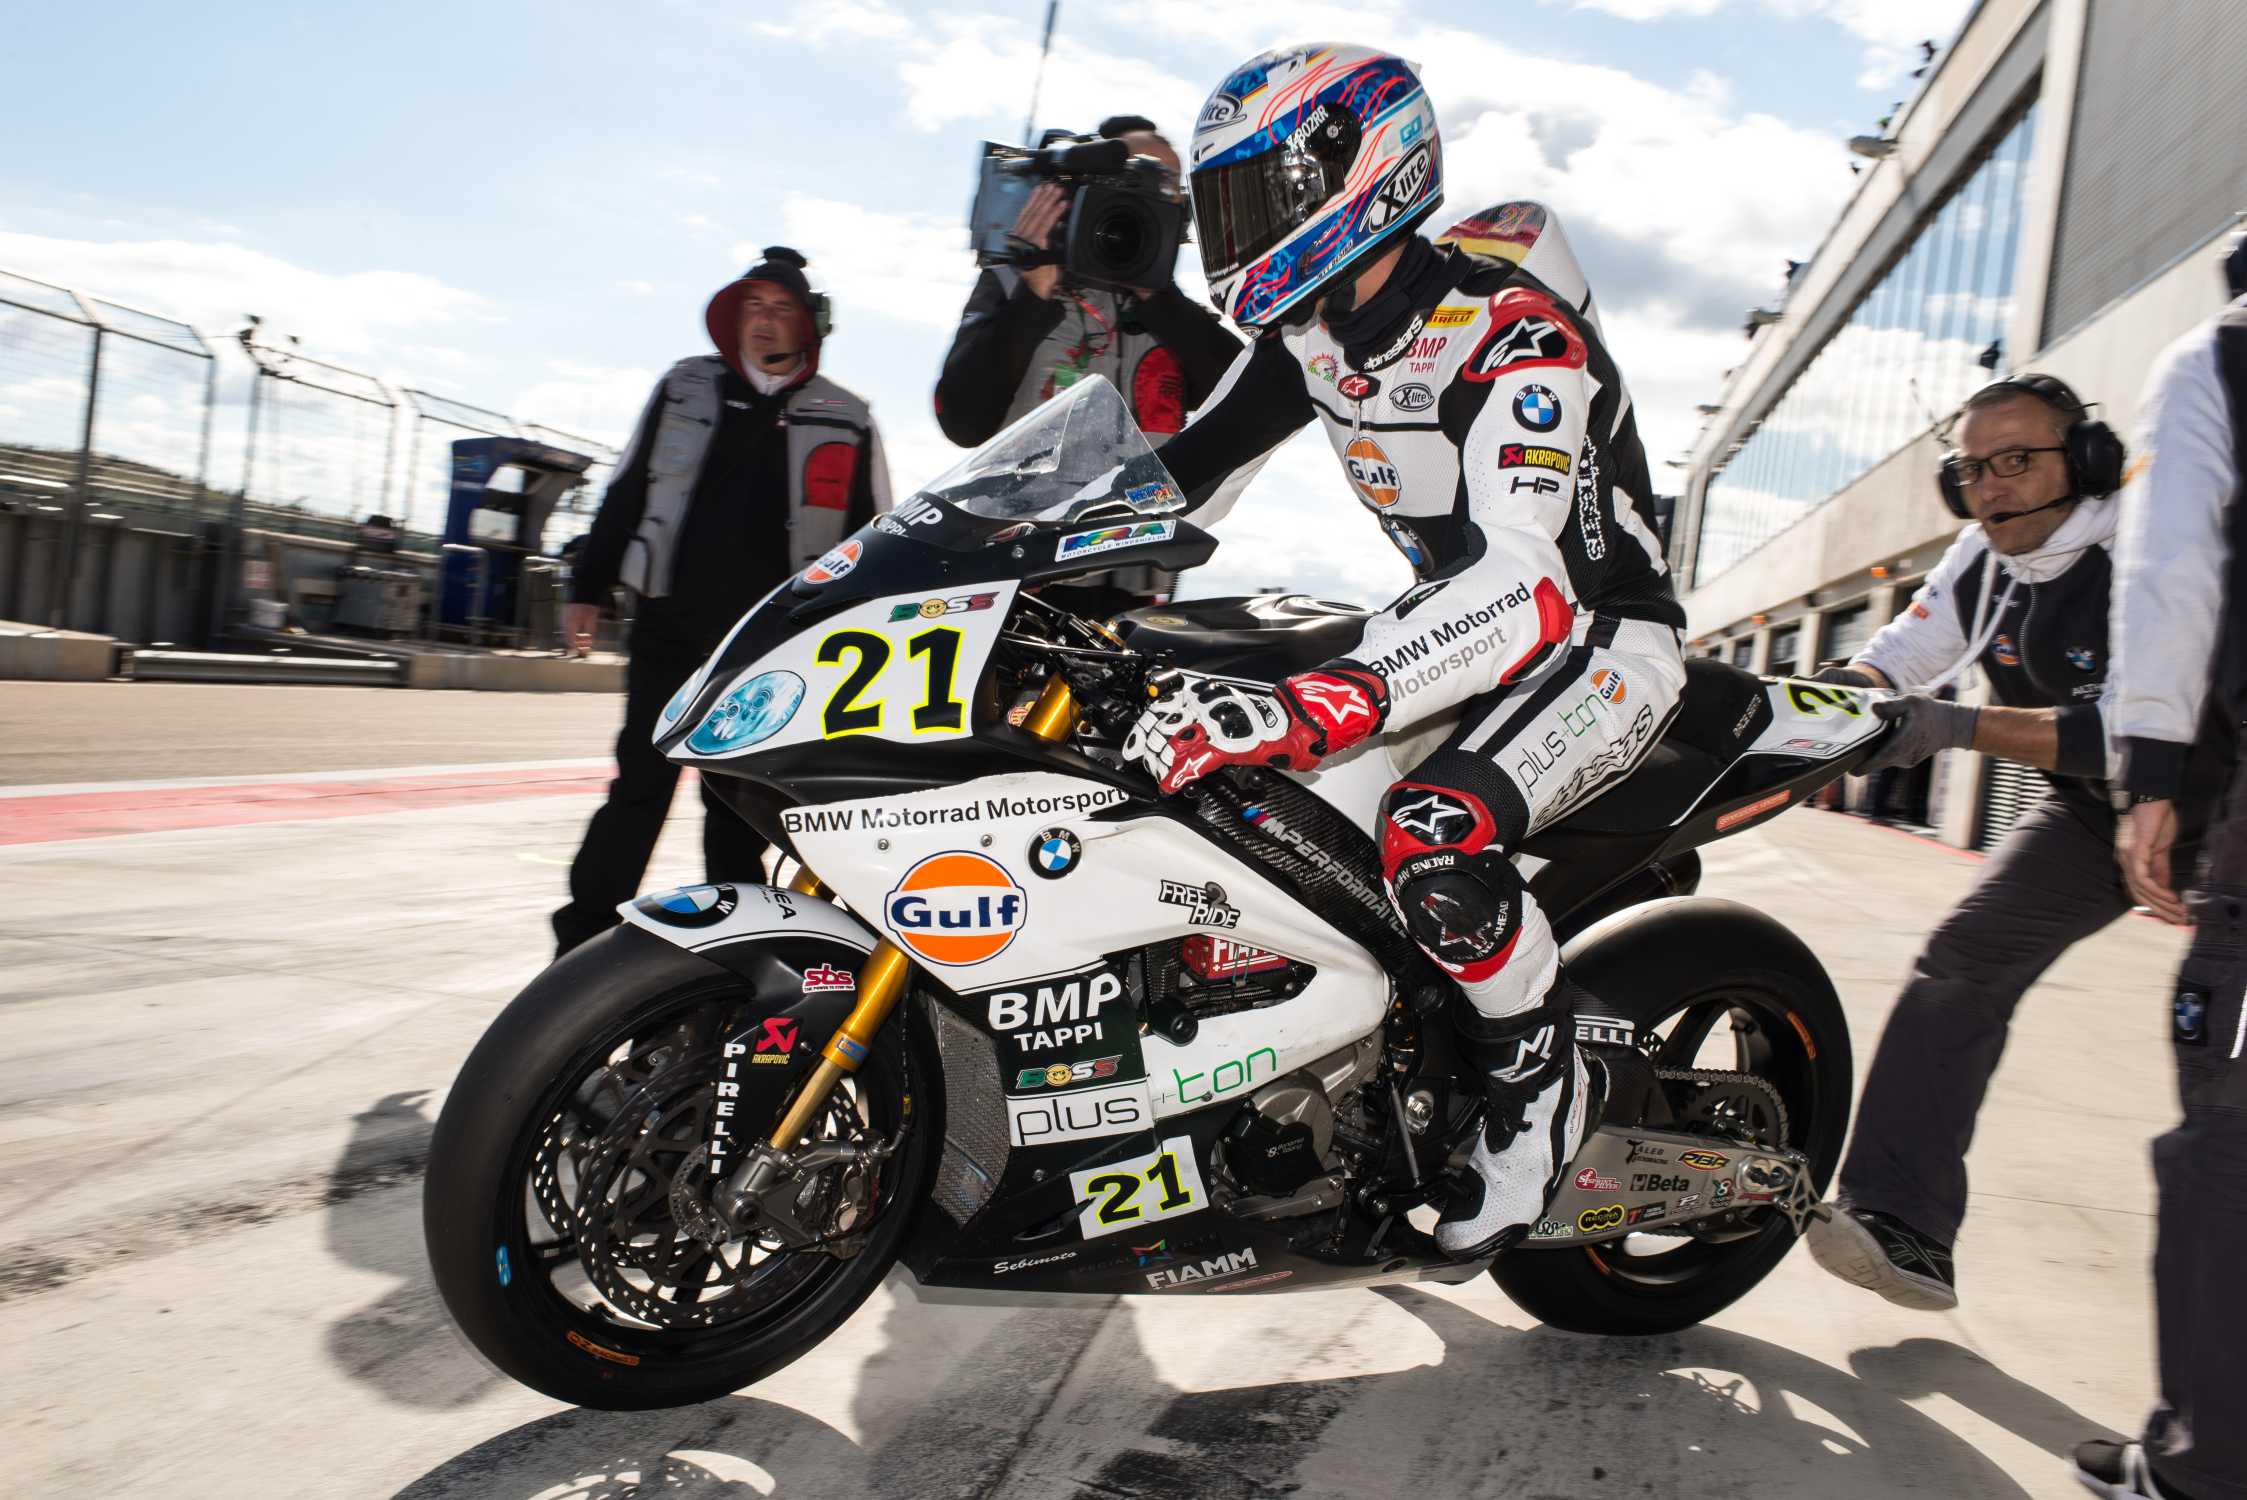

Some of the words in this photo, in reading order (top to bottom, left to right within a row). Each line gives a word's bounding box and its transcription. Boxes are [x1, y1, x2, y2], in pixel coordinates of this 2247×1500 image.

[1376, 154, 1427, 225] X-lite
[1363, 314, 1423, 371] alpinestars
[1410, 362, 1435, 374] TAPPI
[1400, 393, 1427, 406] X-lite
[1515, 384, 1558, 402] BMW
[1347, 459, 1397, 487] Gulf
[1509, 476, 1560, 494] HP
[1369, 634, 1431, 678] BMW
[1430, 581, 1532, 648] Motorrad
[1390, 626, 1508, 702] Motorsport
[816, 625, 965, 739] 21
[1600, 671, 1622, 700] Gulf
[784, 809, 853, 833] BMW
[861, 801, 980, 829] Motorrad
[985, 786, 1128, 821] Motorsport
[1041, 830, 1082, 854] BMW
[1411, 855, 1455, 875] RACING
[1160, 880, 1207, 906] FREE
[890, 895, 1020, 929] Gulf
[1189, 905, 1240, 928] RIDE
[1493, 900, 1509, 939] AHEAD
[806, 964, 854, 986] sbs
[987, 972, 1122, 1031] BMP
[1013, 1022, 1103, 1052] TAPPI
[711, 1042, 746, 1174] PIRELLI
[1016, 1097, 1140, 1146] plus
[1086, 1151, 1192, 1227] 21
[1647, 1174, 1690, 1192] Beta
[993, 1250, 1078, 1275] Sebimoto
[1145, 1247, 1258, 1288] FIAMM
